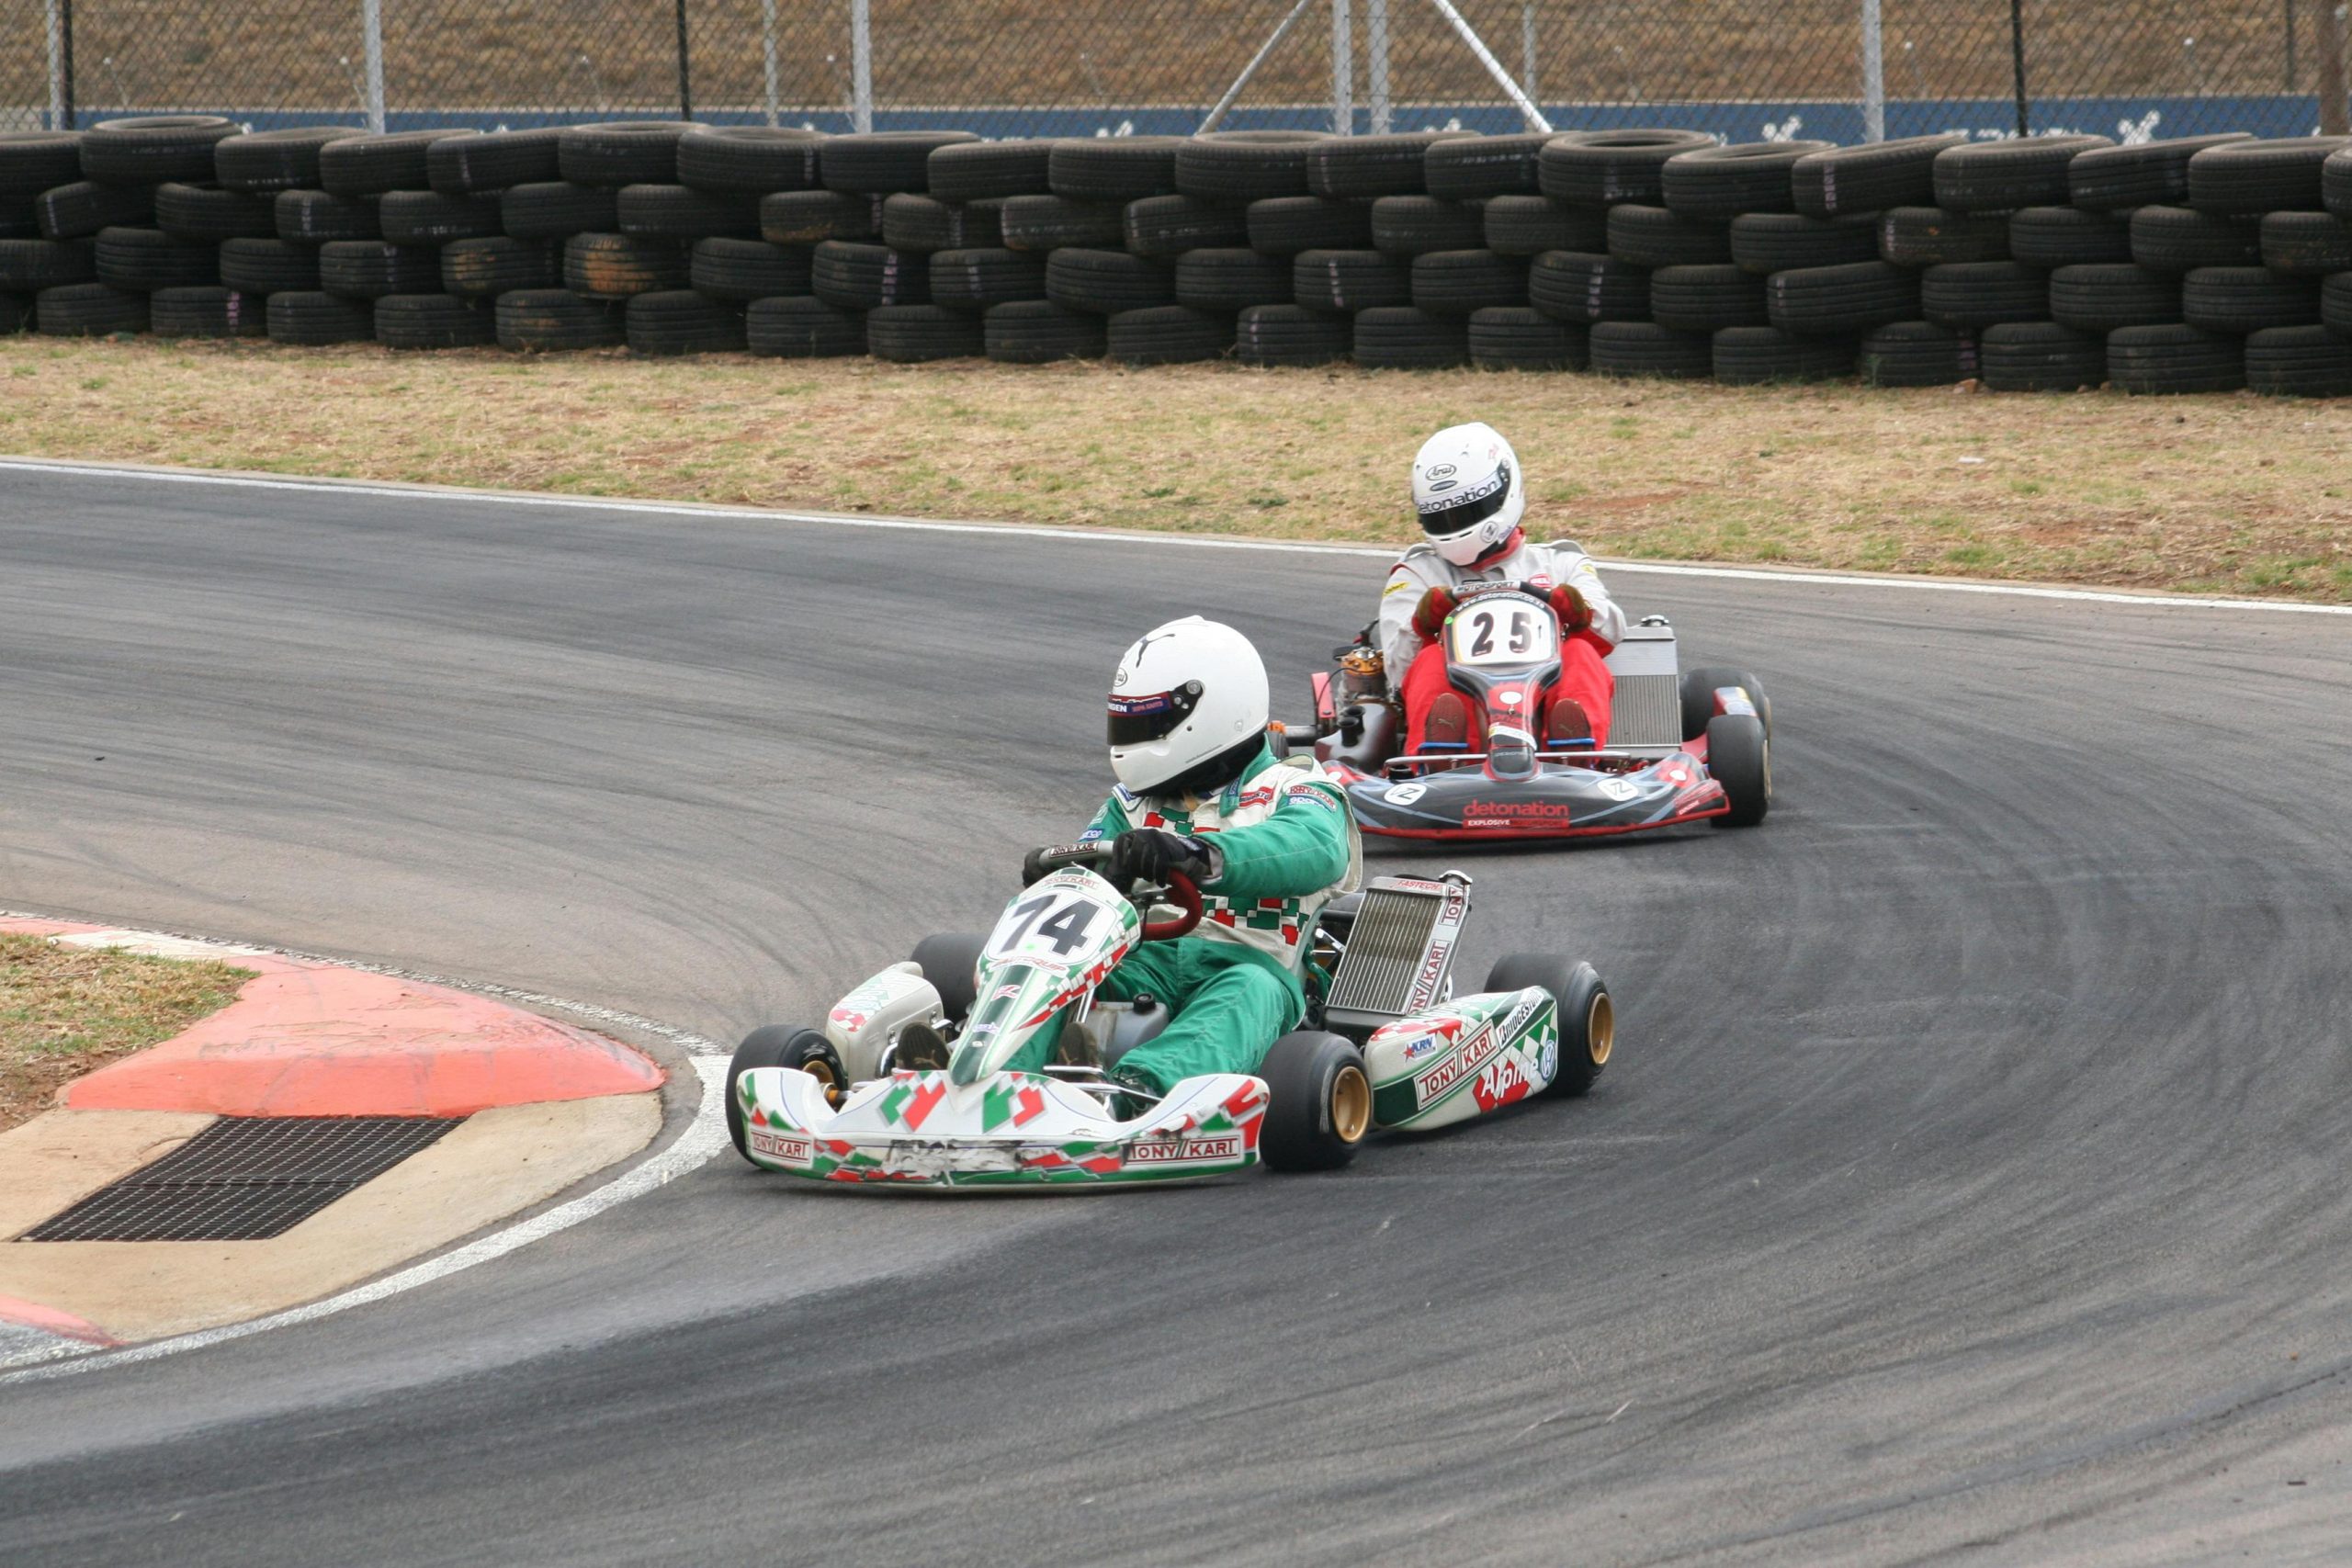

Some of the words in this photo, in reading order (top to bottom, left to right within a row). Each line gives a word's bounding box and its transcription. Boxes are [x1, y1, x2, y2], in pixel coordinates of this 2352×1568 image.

[1419, 479, 1498, 513] etonation
[1463, 798, 1569, 817] detonation
[1000, 893, 1101, 956] 74
[1421, 1061, 1457, 1096] TONY
[1462, 1028, 1495, 1066] KART
[1481, 1057, 1540, 1100] Alpine
[1190, 1139, 1235, 1156] KART
